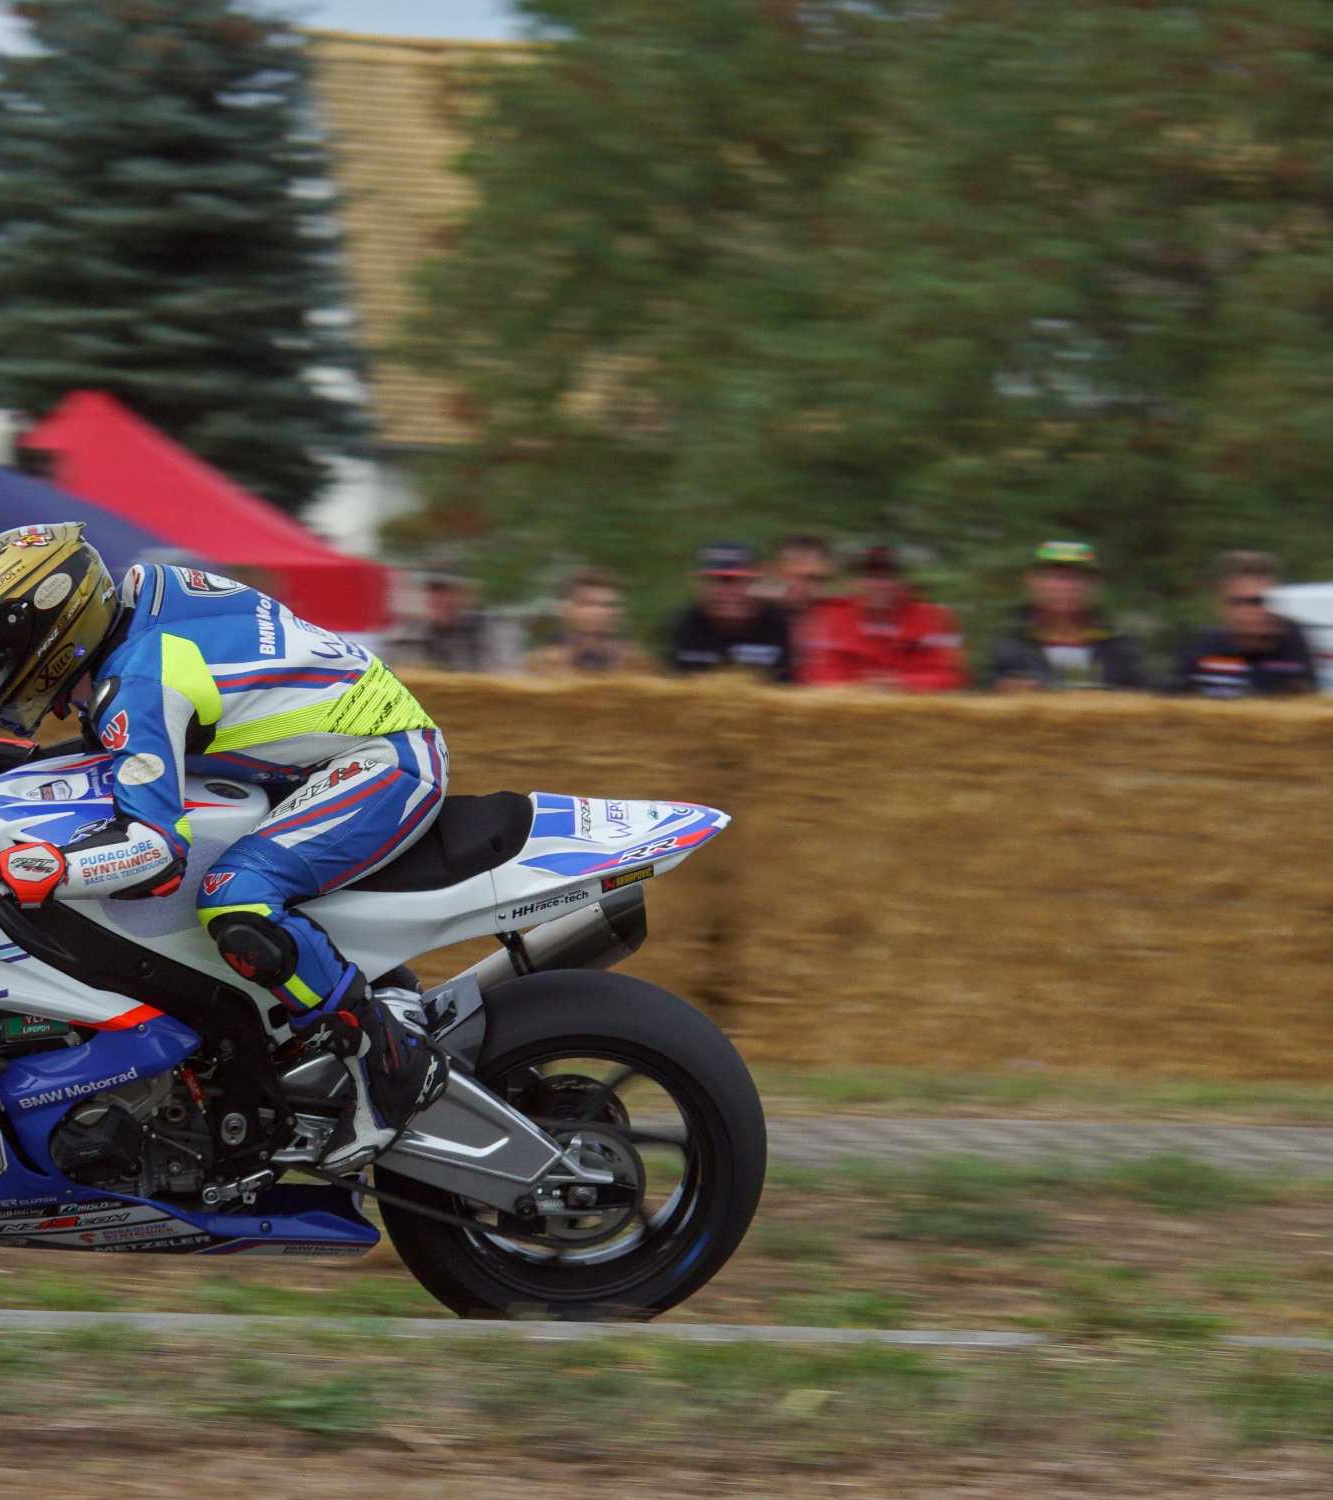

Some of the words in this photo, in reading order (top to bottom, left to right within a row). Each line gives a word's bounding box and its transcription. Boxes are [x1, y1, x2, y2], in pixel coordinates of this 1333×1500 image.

[80, 839, 154, 868] PURAGLOBE
[82, 848, 162, 878] SYNTAINICS
[19, 1088, 63, 1110] BMW
[66, 1066, 139, 1100] Motorrad
